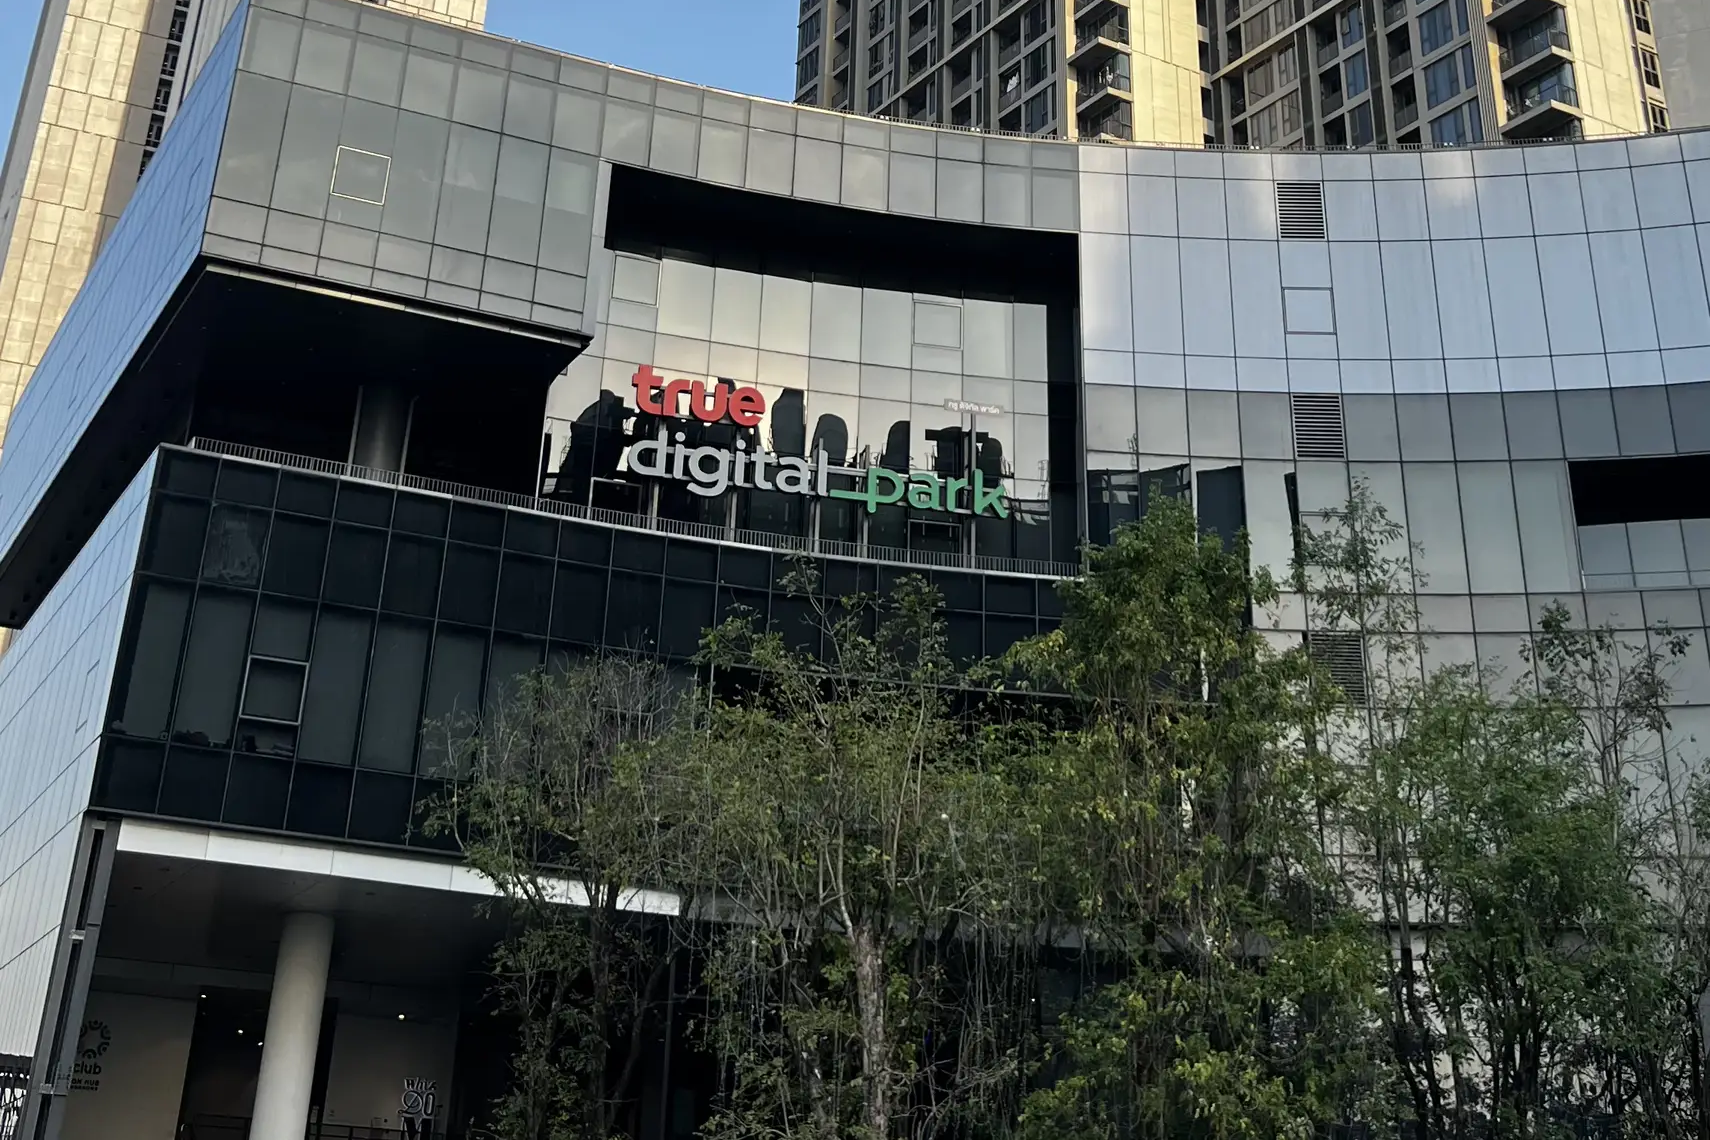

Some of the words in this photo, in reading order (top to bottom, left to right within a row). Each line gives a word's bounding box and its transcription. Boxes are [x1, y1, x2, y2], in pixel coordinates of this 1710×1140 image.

[632, 364, 766, 427] true
[627, 430, 829, 497] digital
[829, 465, 1008, 519] park
